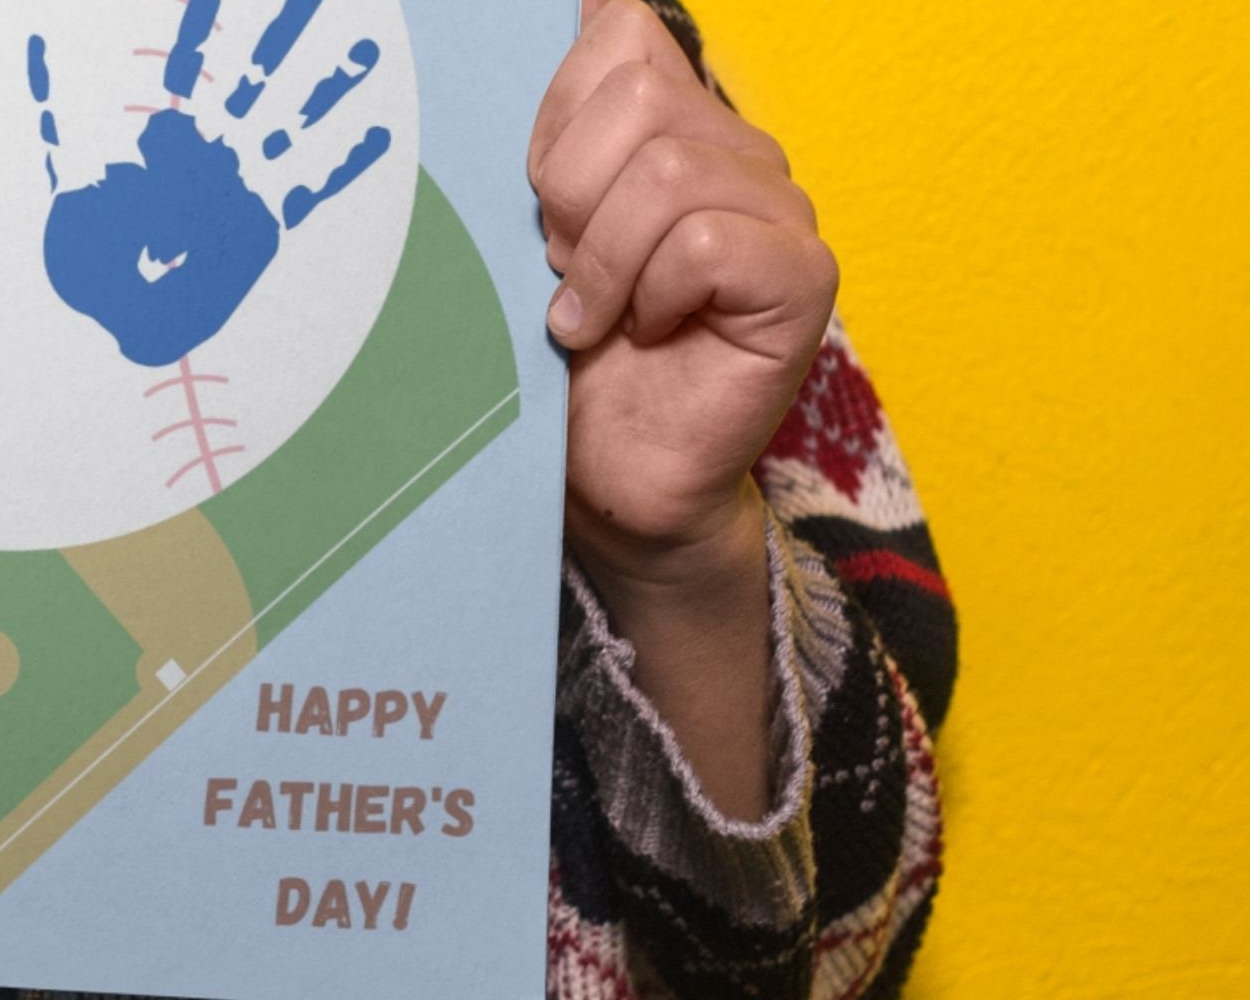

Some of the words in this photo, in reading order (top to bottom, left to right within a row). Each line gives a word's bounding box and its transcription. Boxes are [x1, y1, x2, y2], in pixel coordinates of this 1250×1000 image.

[255, 682, 448, 741] HAPPY
[203, 777, 476, 838] FATHER'S
[274, 876, 417, 931] DAY!
